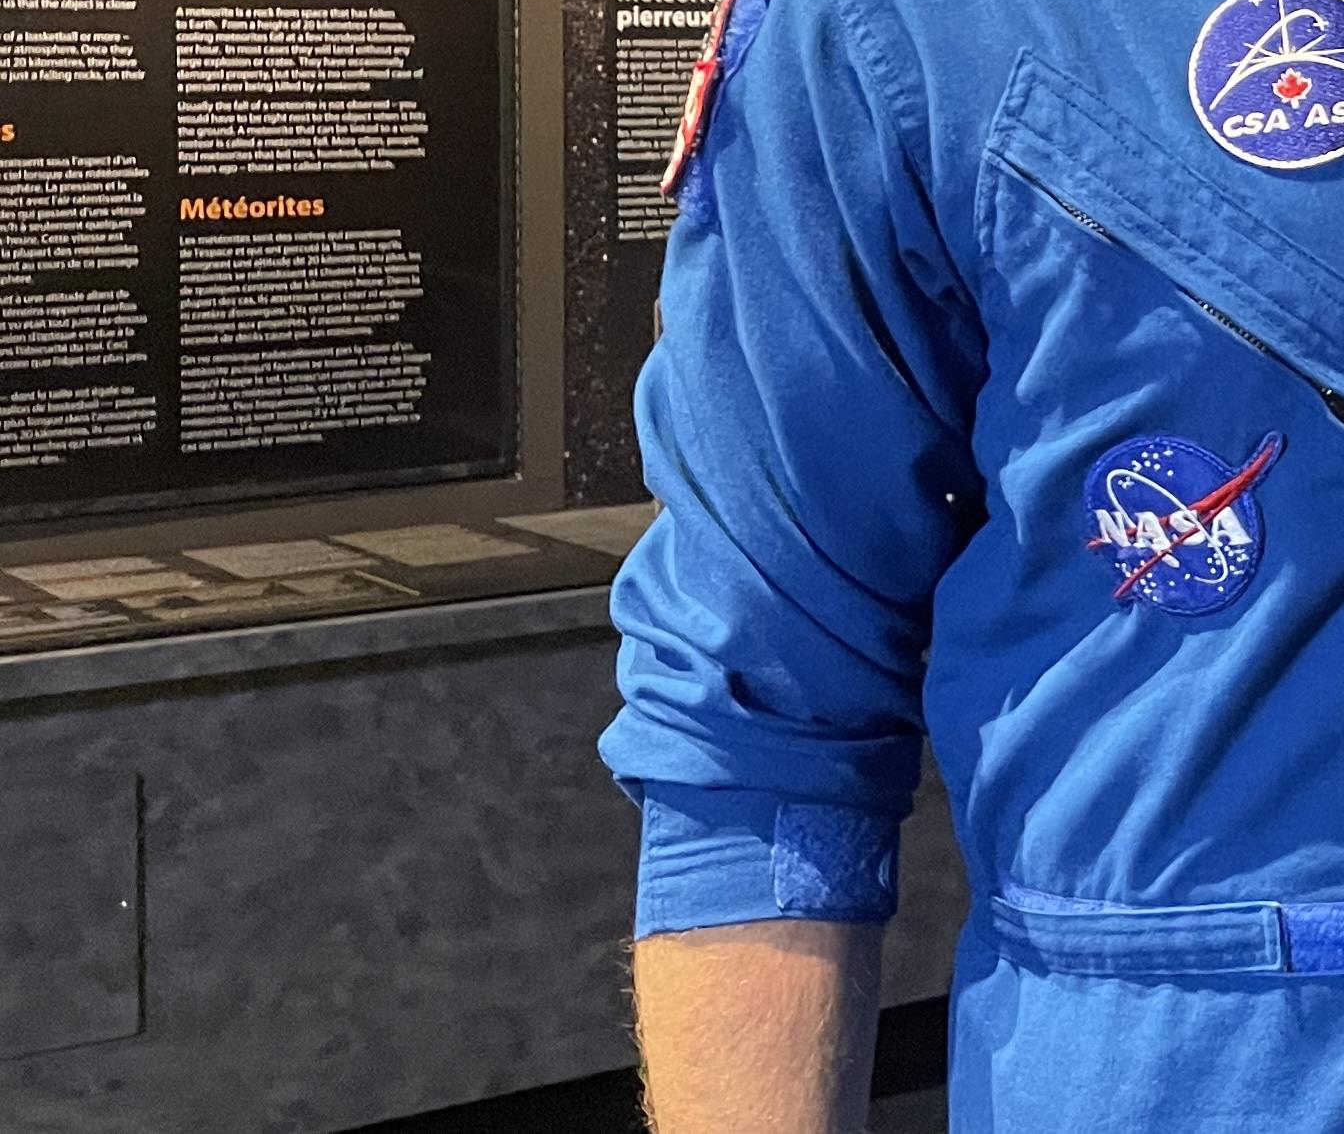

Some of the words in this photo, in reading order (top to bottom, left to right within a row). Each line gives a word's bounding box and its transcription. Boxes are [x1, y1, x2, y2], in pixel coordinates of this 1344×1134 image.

[1222, 108, 1290, 138] CSA
[180, 196, 325, 220] Météorites
[1093, 506, 1253, 551] NASA
